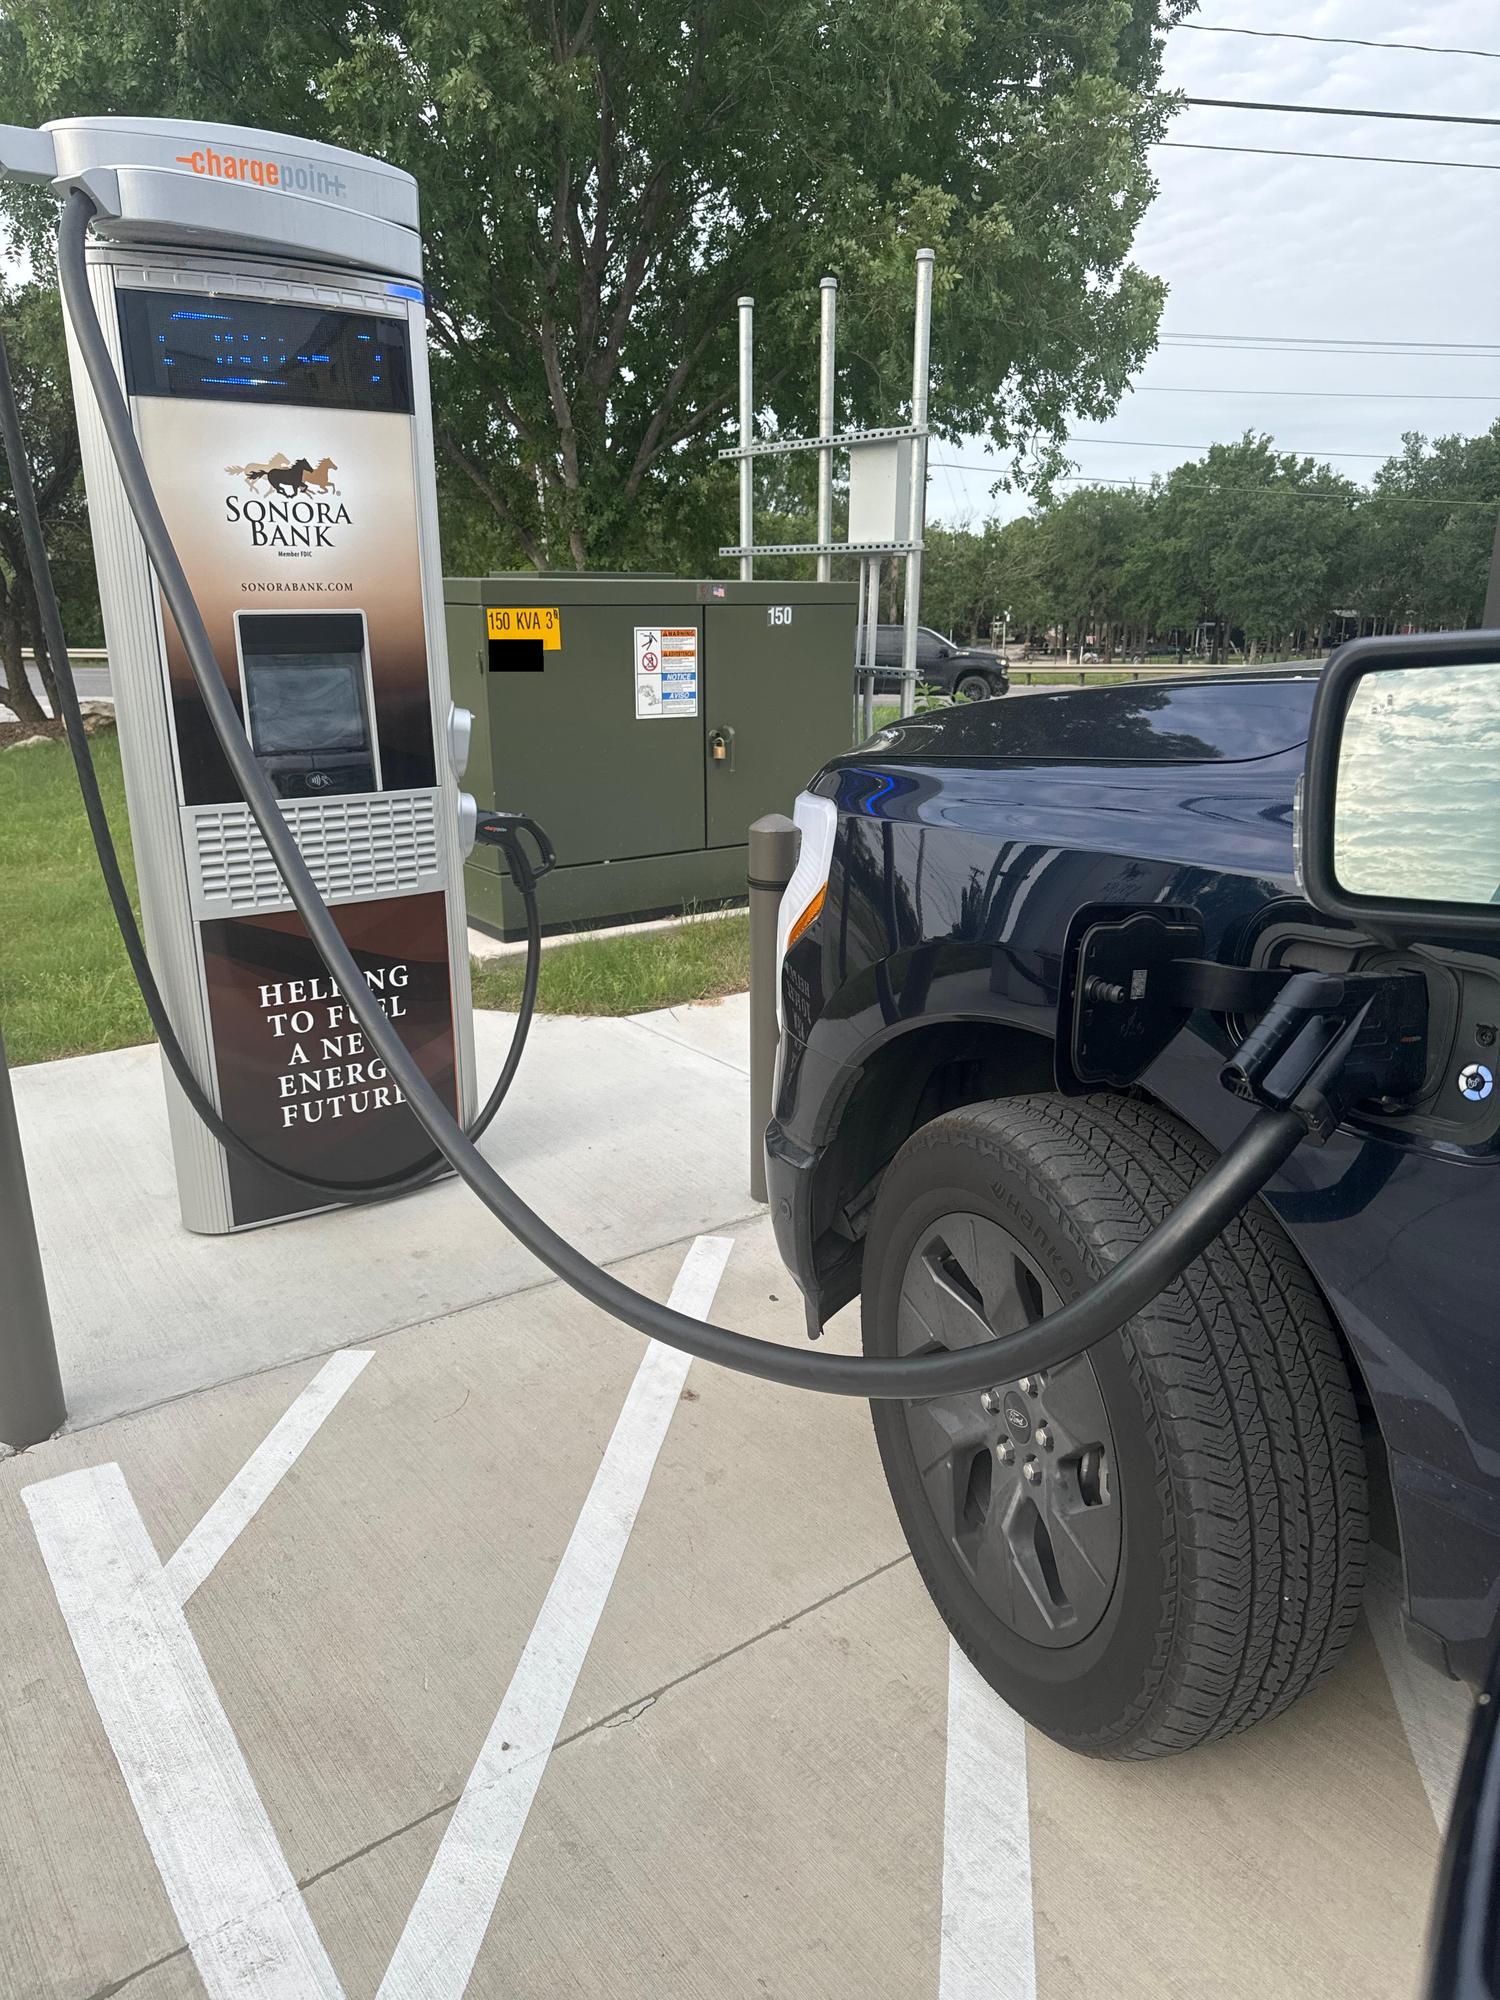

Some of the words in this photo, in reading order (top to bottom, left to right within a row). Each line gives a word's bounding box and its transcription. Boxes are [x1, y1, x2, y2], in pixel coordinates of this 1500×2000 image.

[225, 495, 354, 525] SONORA
[251, 519, 336, 547] BANK
[278, 550, 300, 558] Member
[241, 582, 353, 592] SONORABANK.COM
[488, 611, 511, 630] 150
[516, 611, 541, 630] KVA
[768, 606, 792, 625] 150
[666, 673, 691, 681] NOTICE
[669, 692, 690, 700] AVISO
[257, 964, 409, 1008] HELNG
[267, 1010, 314, 1038] TO
[288, 1042, 310, 1066] A
[320, 1032, 365, 1061] NE
[277, 1057, 388, 1098] ENERG
